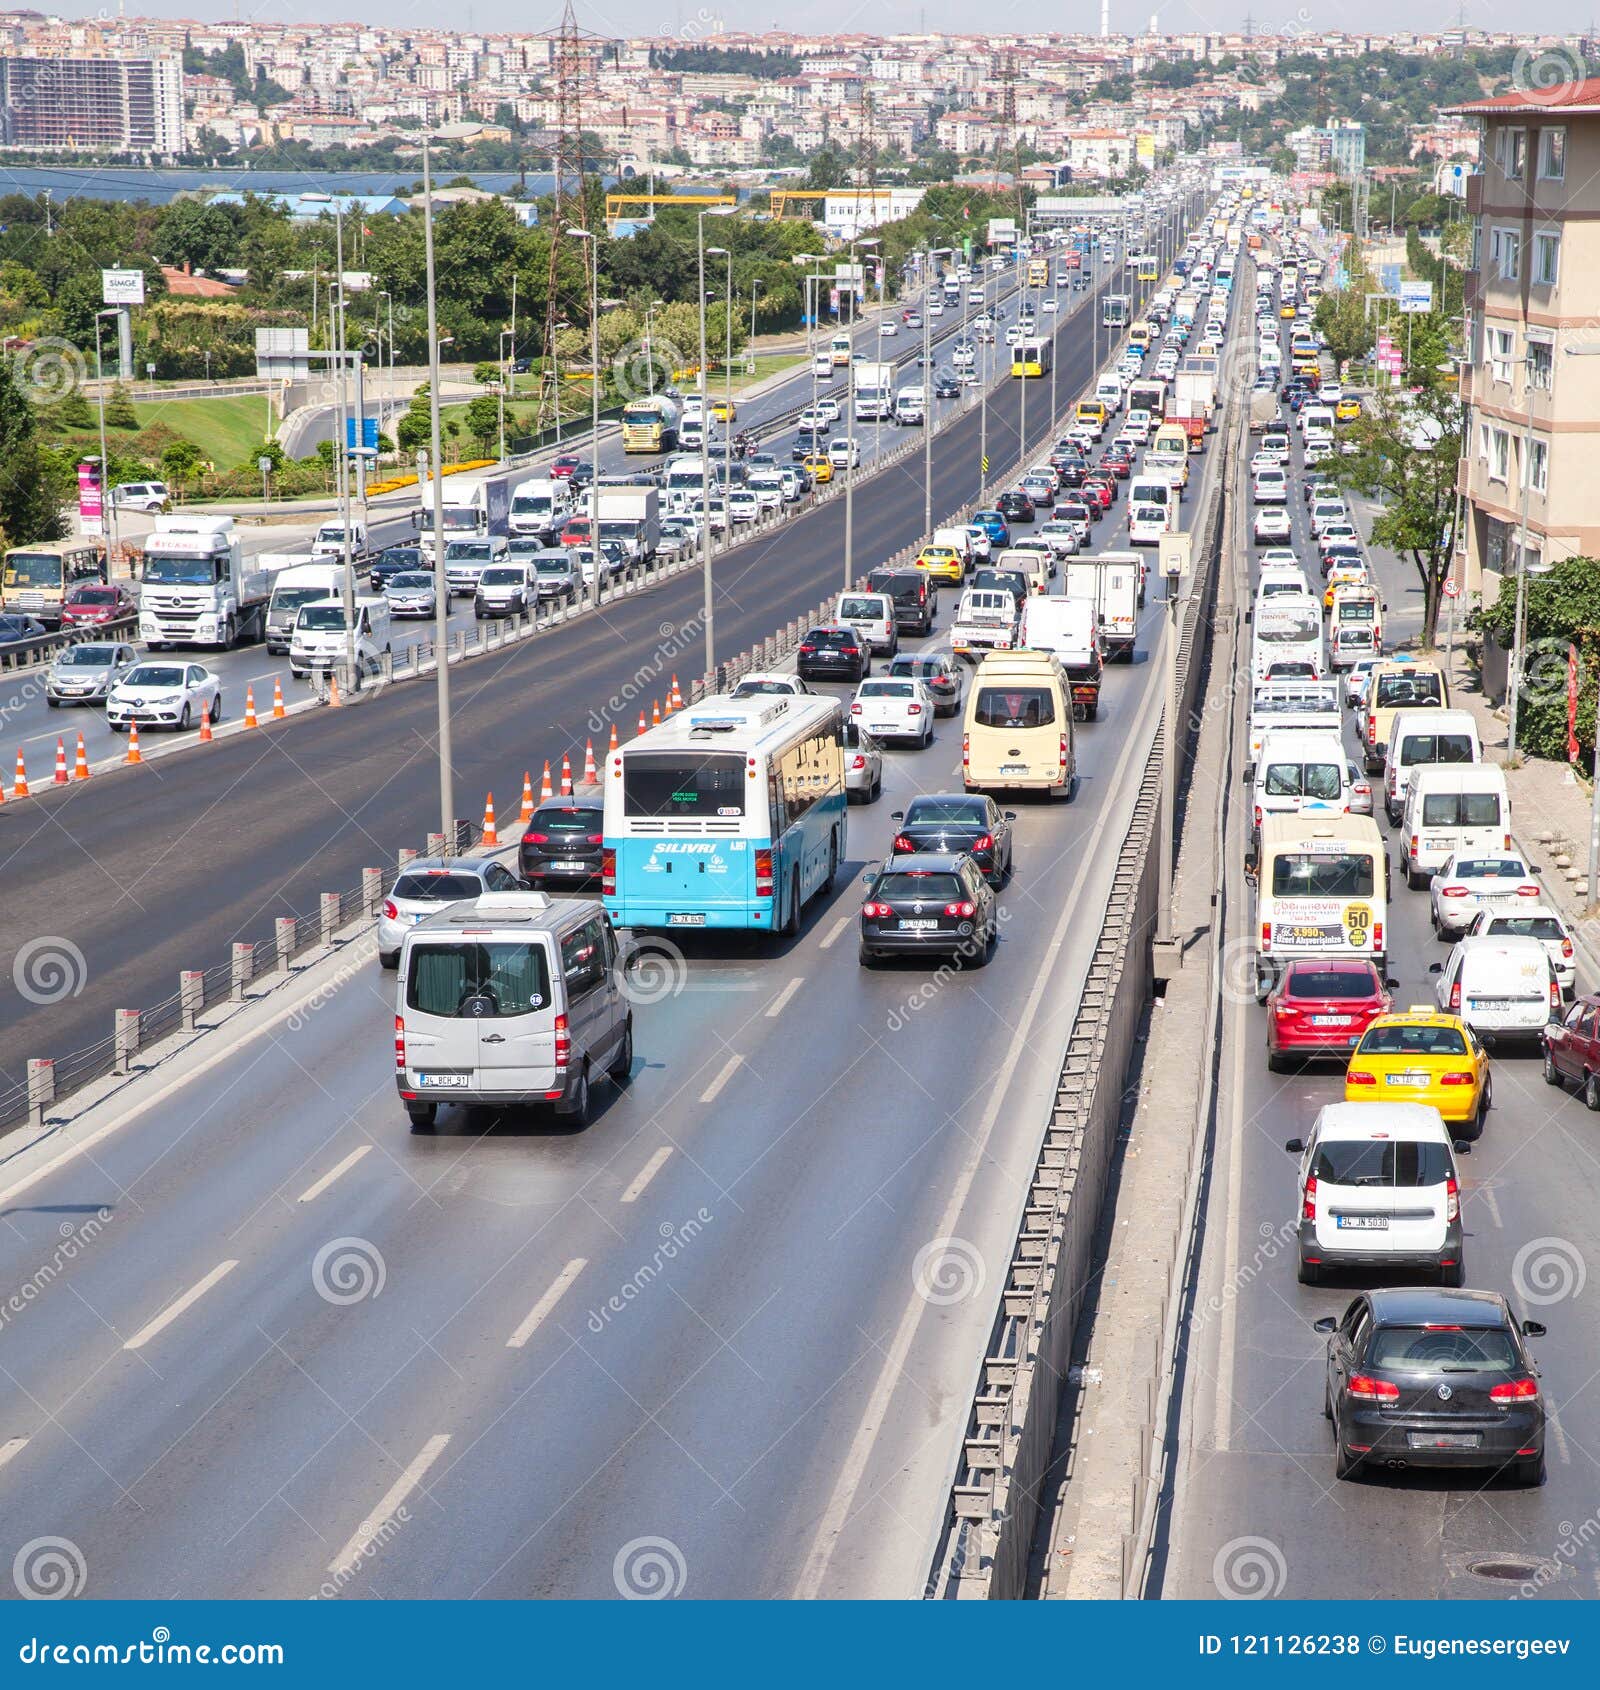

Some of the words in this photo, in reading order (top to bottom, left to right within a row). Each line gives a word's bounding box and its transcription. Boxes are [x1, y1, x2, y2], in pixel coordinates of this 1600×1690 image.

[1446, 582, 1459, 592] 50
[671, 915, 678, 924] 34
[1348, 911, 1369, 928] 50
[1293, 927, 1319, 937] 3.990
[424, 1076, 434, 1085] 34
[439, 1076, 452, 1085] BCH
[457, 1076, 466, 1085] 91
[1391, 1075, 1399, 1084] 34
[1342, 1217, 1351, 1226] 34
[1356, 1217, 1366, 1226] JN
[1368, 1218, 1387, 1227] 5030
